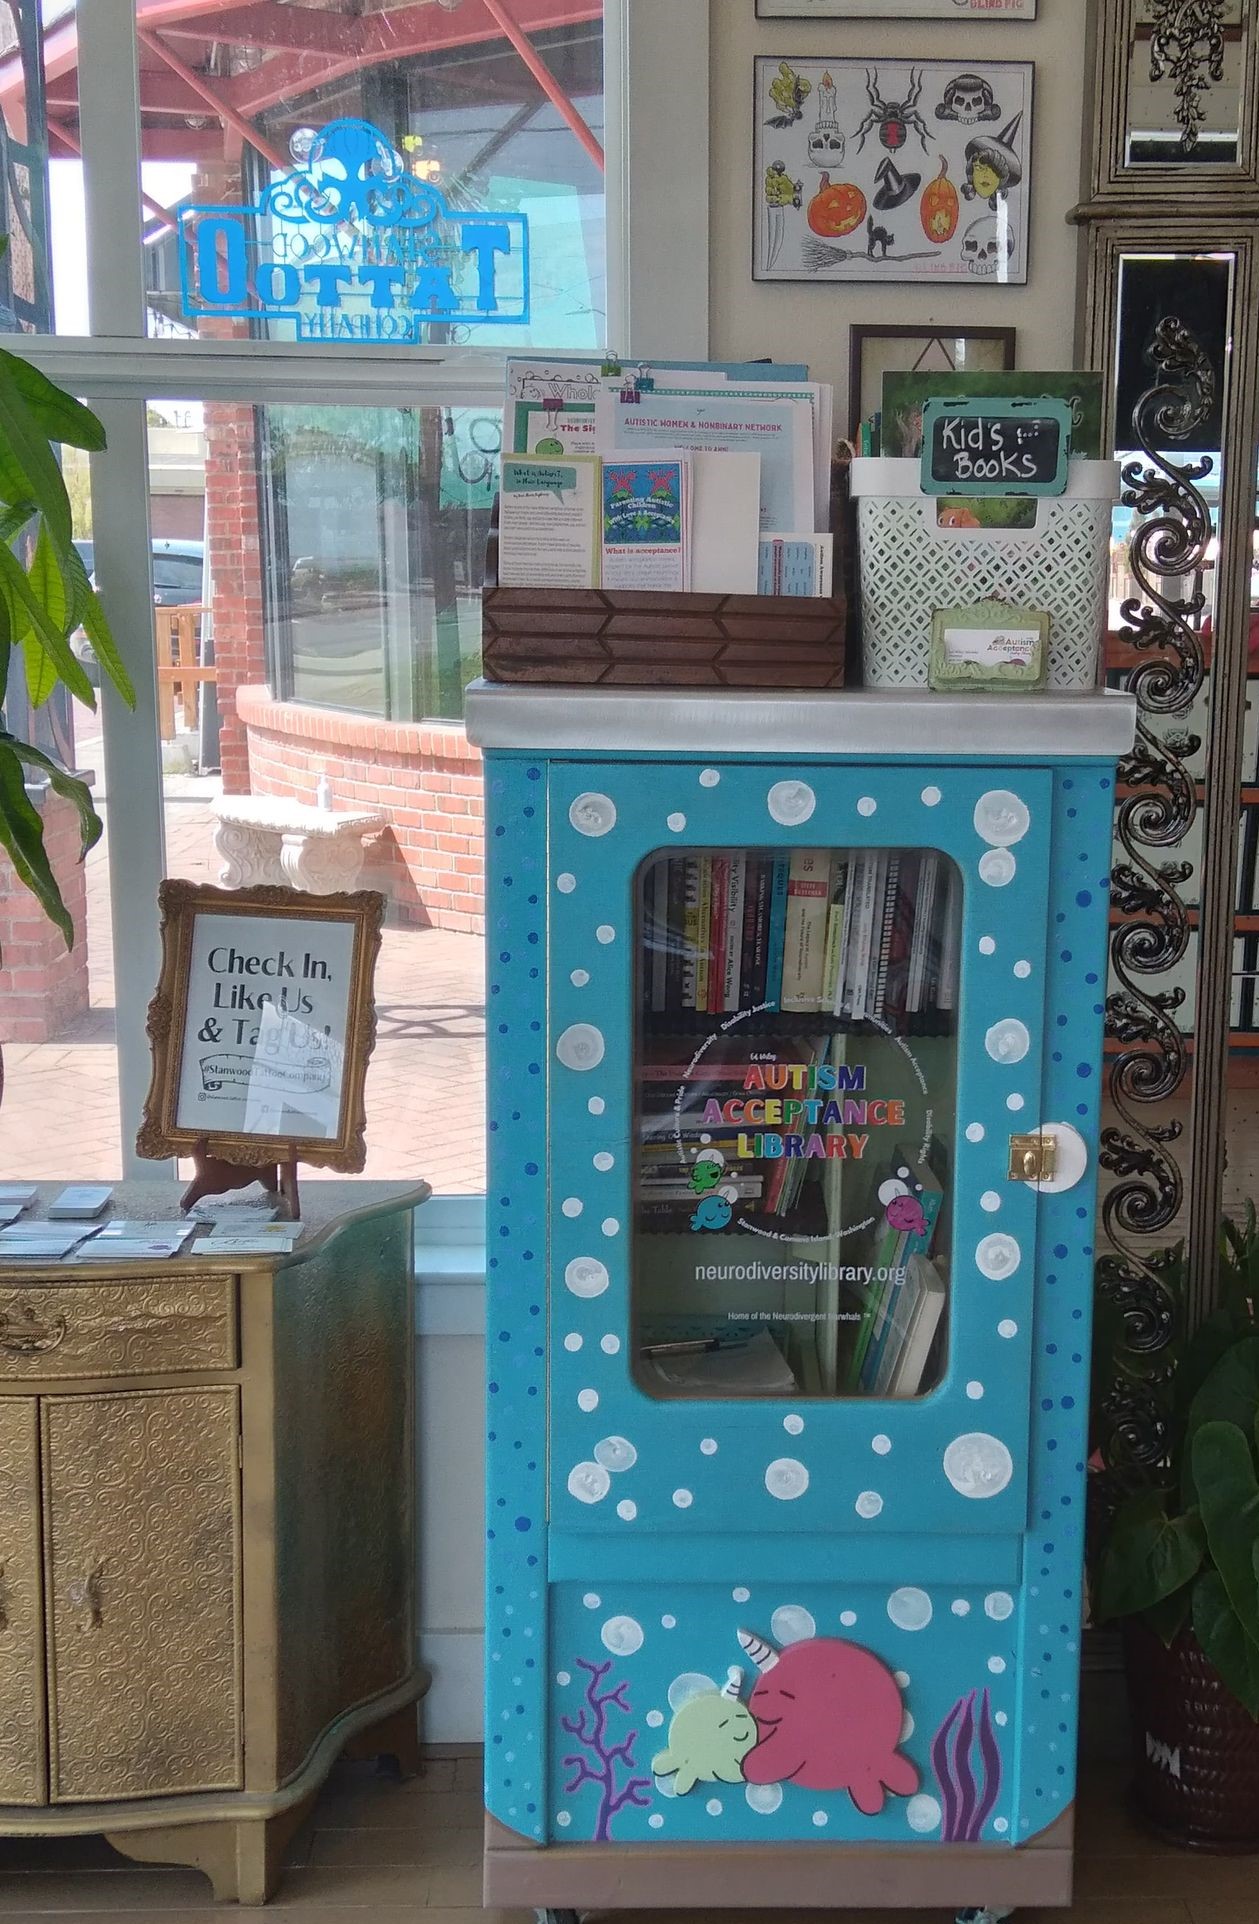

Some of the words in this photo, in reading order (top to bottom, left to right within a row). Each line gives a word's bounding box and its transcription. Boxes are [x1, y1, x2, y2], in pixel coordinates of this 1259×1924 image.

[560, 424, 579, 432] The
[624, 418, 658, 427] AUTISTIC
[660, 419, 688, 428] WOMEN
[698, 421, 743, 431] NONBINARY
[745, 423, 782, 432] NETWORK
[942, 417, 1004, 451] Kid's
[513, 469, 529, 477] What
[536, 478, 563, 488] Language
[610, 497, 646, 509] Parenting
[646, 496, 674, 509] Autistic
[622, 511, 637, 519] Love
[627, 502, 657, 510] Children
[635, 547, 681, 556] acceptance?
[987, 644, 1030, 652] Acceptanc
[1005, 638, 1036, 646] Autism
[729, 875, 739, 912] Visibility
[207, 947, 295, 978] Check
[302, 953, 332, 982] In,
[213, 982, 273, 1011] Like
[280, 987, 313, 1014] Us
[724, 977, 733, 998] Wong
[720, 1009, 752, 1031] Disability
[752, 1001, 776, 1013] Justice
[197, 1017, 224, 1044] &
[232, 1018, 280, 1056] Tag
[289, 1022, 331, 1052] Us!
[682, 1032, 717, 1079] Neurodiversity
[894, 1036, 913, 1058] Autism
[910, 1057, 928, 1095] Acceptance
[743, 1063, 867, 1091] AUTISM
[675, 1085, 685, 1105] Pride
[702, 1097, 906, 1126] ACCEPTANCE
[673, 1111, 681, 1139] Culture
[925, 1109, 934, 1143] Disability
[676, 1139, 686, 1163] Autistic
[737, 1132, 870, 1160] LIBRARY
[917, 1143, 931, 1165] Rights
[737, 1217, 772, 1239] Stanwood
[771, 1230, 778, 1240] &
[780, 1232, 809, 1243] Camano
[836, 1216, 876, 1239] Washington
[695, 1260, 907, 1286] neurodiversitylibrary.org
[728, 1311, 749, 1320] Home
[751, 1311, 758, 1320] of
[759, 1311, 771, 1320] the
[772, 1311, 827, 1322] Neurodivergent
